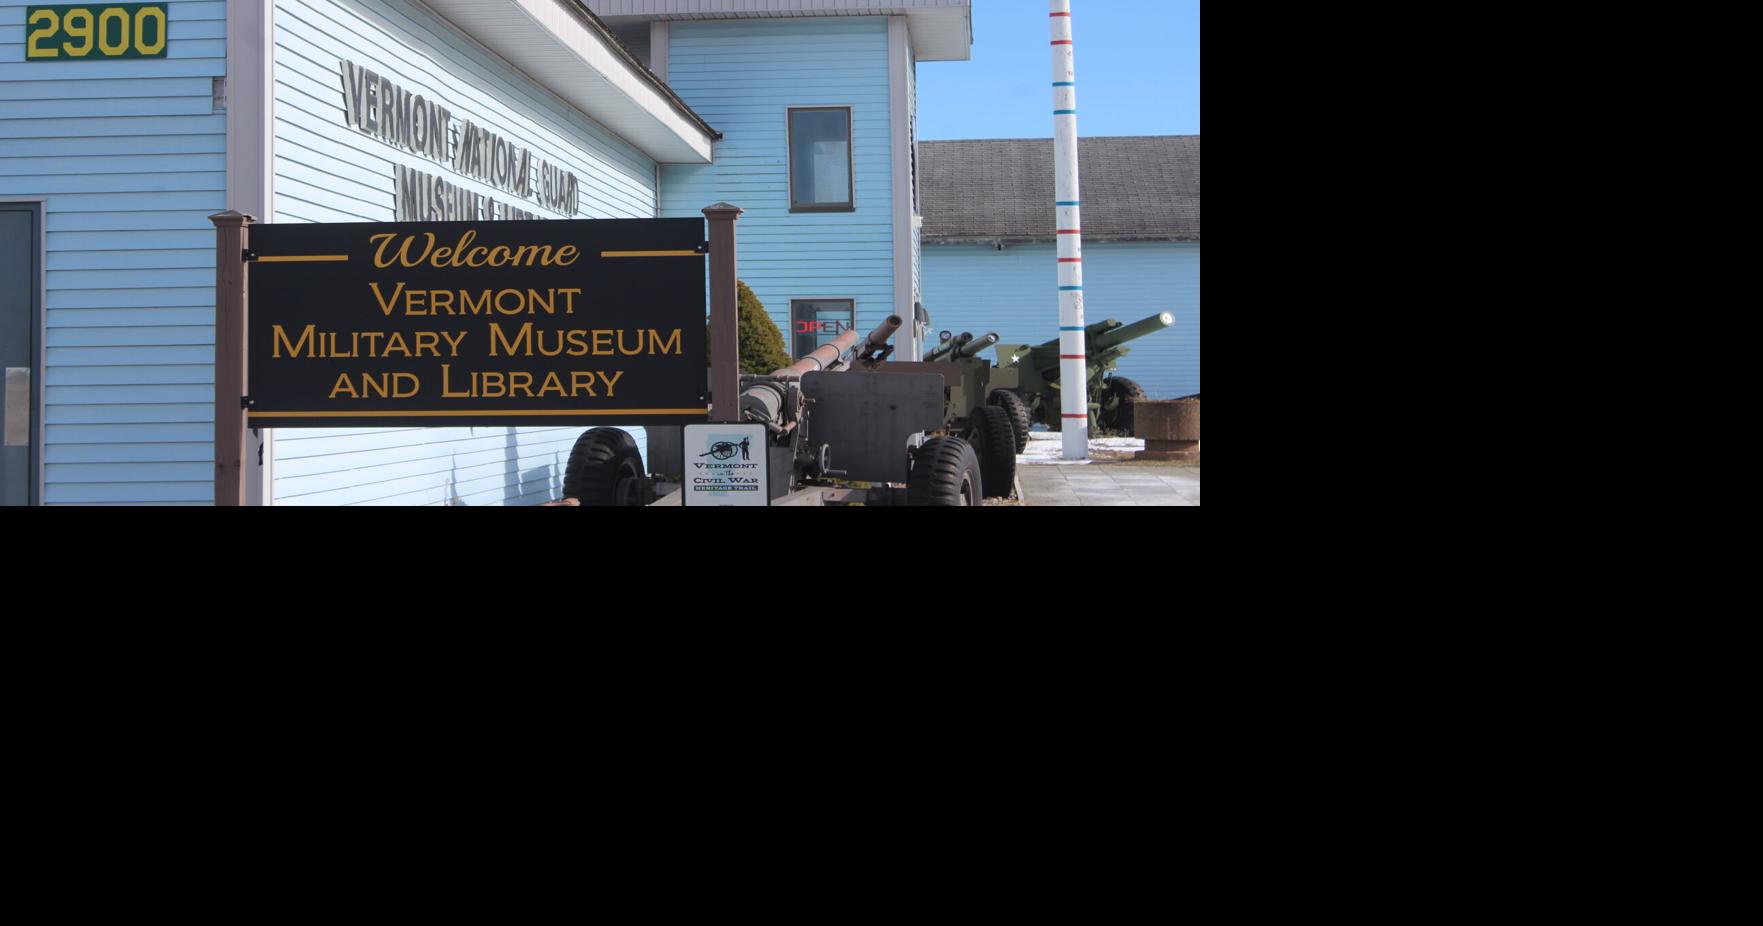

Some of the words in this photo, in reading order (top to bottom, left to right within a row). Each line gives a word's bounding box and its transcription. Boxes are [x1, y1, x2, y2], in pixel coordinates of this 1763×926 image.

[28, 7, 166, 57] 2900
[340, 59, 450, 163] VERMONT
[453, 118, 533, 199] NATIONAL
[537, 158, 579, 217] GUARD
[369, 230, 580, 268] Welcome
[369, 282, 582, 316] VERMONT
[271, 324, 468, 359] MILITARY
[489, 322, 683, 358] MUSEUM
[328, 372, 421, 399] AND
[441, 364, 624, 399] LIBRARY
